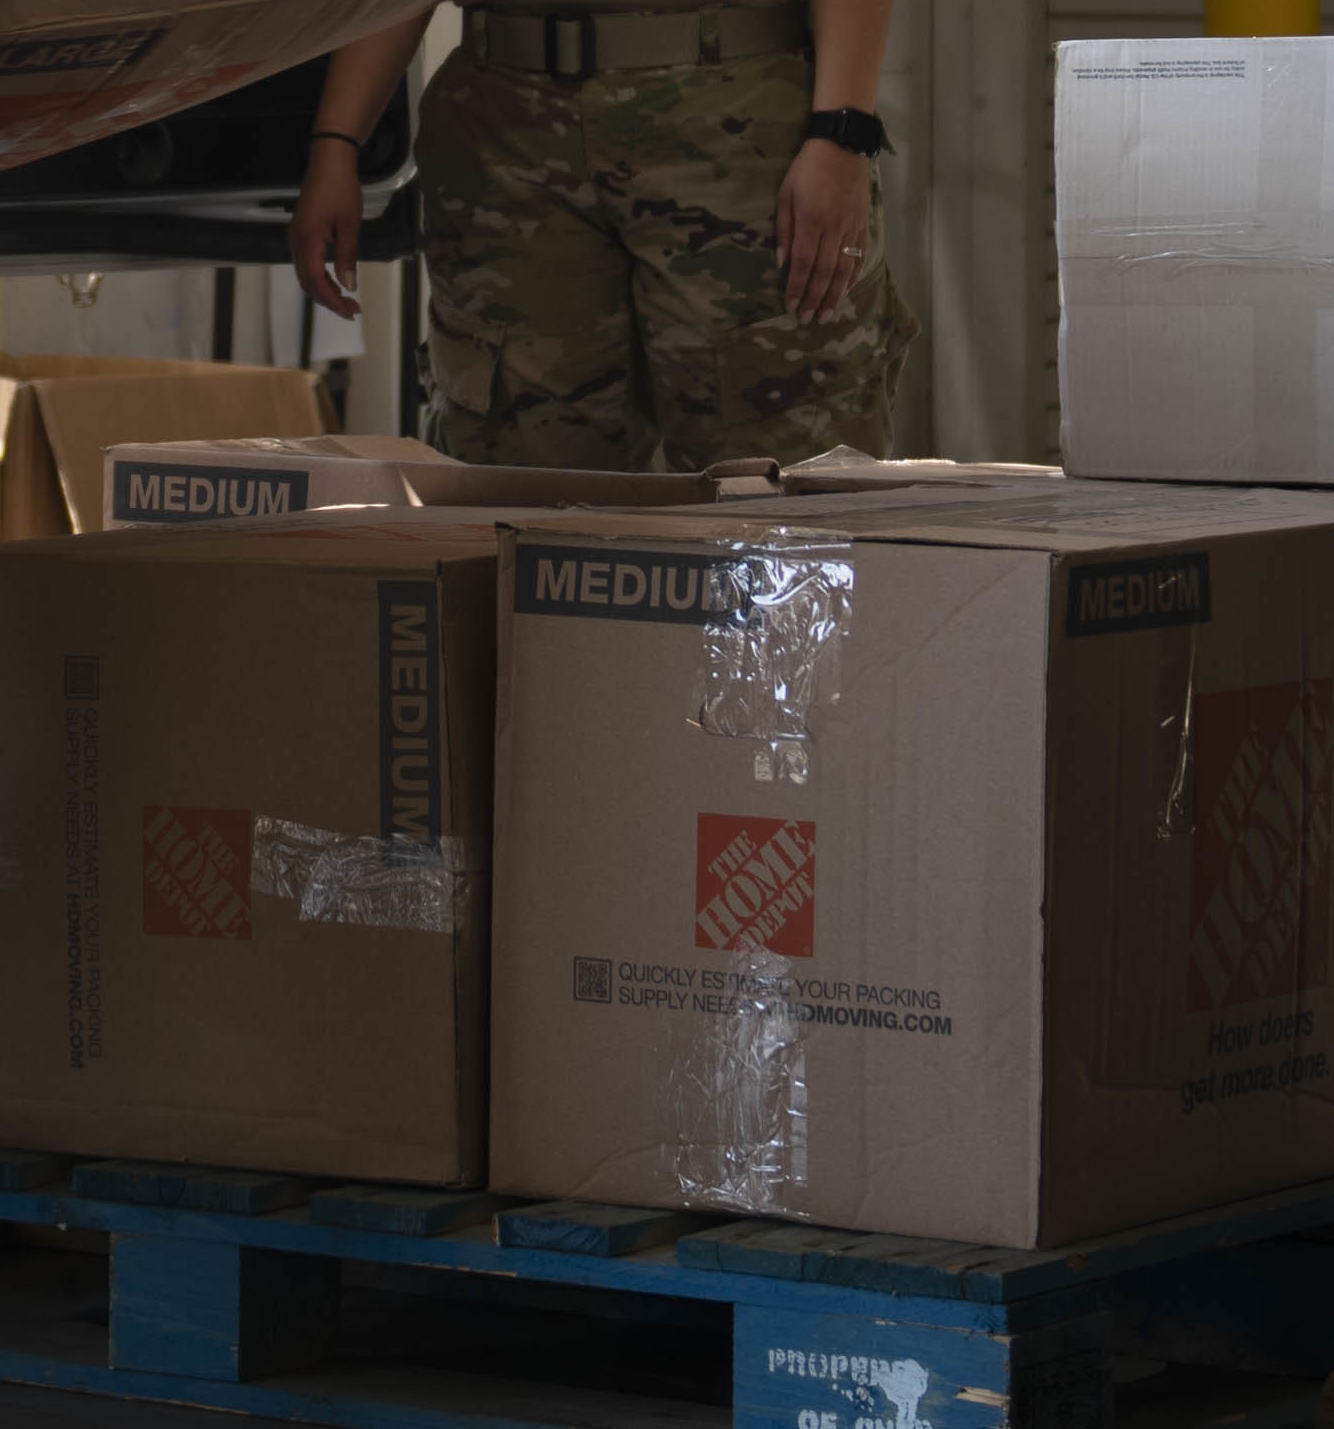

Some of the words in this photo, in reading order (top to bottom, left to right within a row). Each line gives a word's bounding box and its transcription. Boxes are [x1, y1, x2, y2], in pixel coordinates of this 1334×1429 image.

[129, 474, 291, 516] MEDIUM
[1079, 567, 1200, 621] MEDIUM
[200, 820, 243, 871] THE
[708, 830, 757, 881] THE
[143, 807, 252, 939] HOME
[145, 856, 214, 938] DEPOT
[696, 819, 816, 949] HOME
[741, 872, 815, 955] DEPOT
[618, 961, 696, 988] QUICKLY
[795, 978, 852, 1002] YOUR
[857, 983, 941, 1009] PACKING
[618, 985, 688, 1013] SUPPLY
[1207, 1019, 1253, 1057] How
[1259, 1008, 1315, 1047] doers
[1179, 1070, 1214, 1115] get
